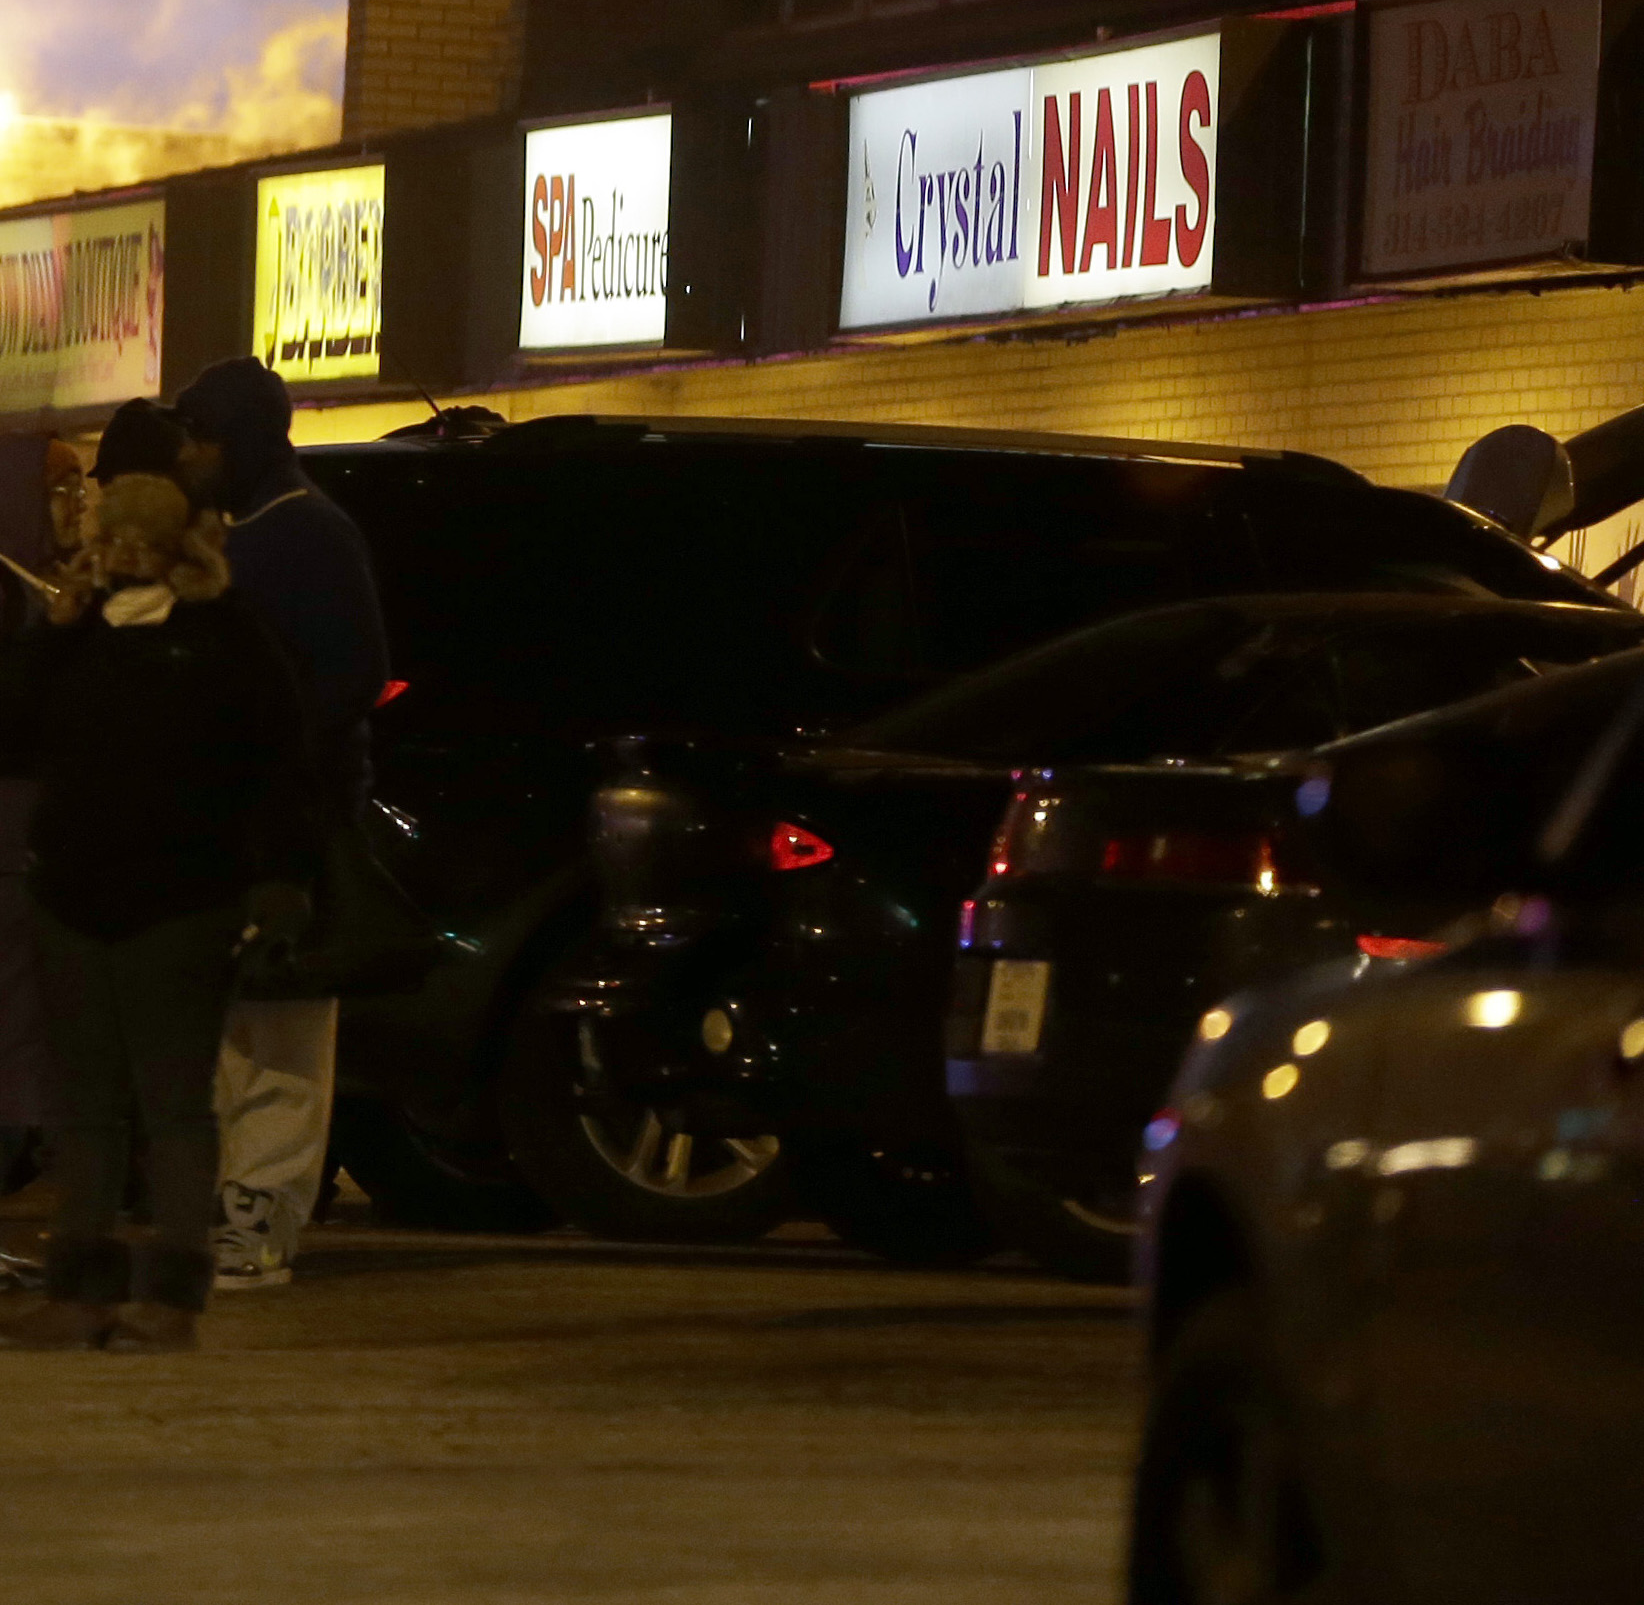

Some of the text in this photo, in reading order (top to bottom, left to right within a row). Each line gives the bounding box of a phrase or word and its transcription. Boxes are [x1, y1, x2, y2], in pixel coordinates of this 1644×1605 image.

[1401, 8, 1561, 106] DABA
[530, 173, 669, 309] SPA Pedicure
[895, 70, 1211, 313] Crystal NAILS
